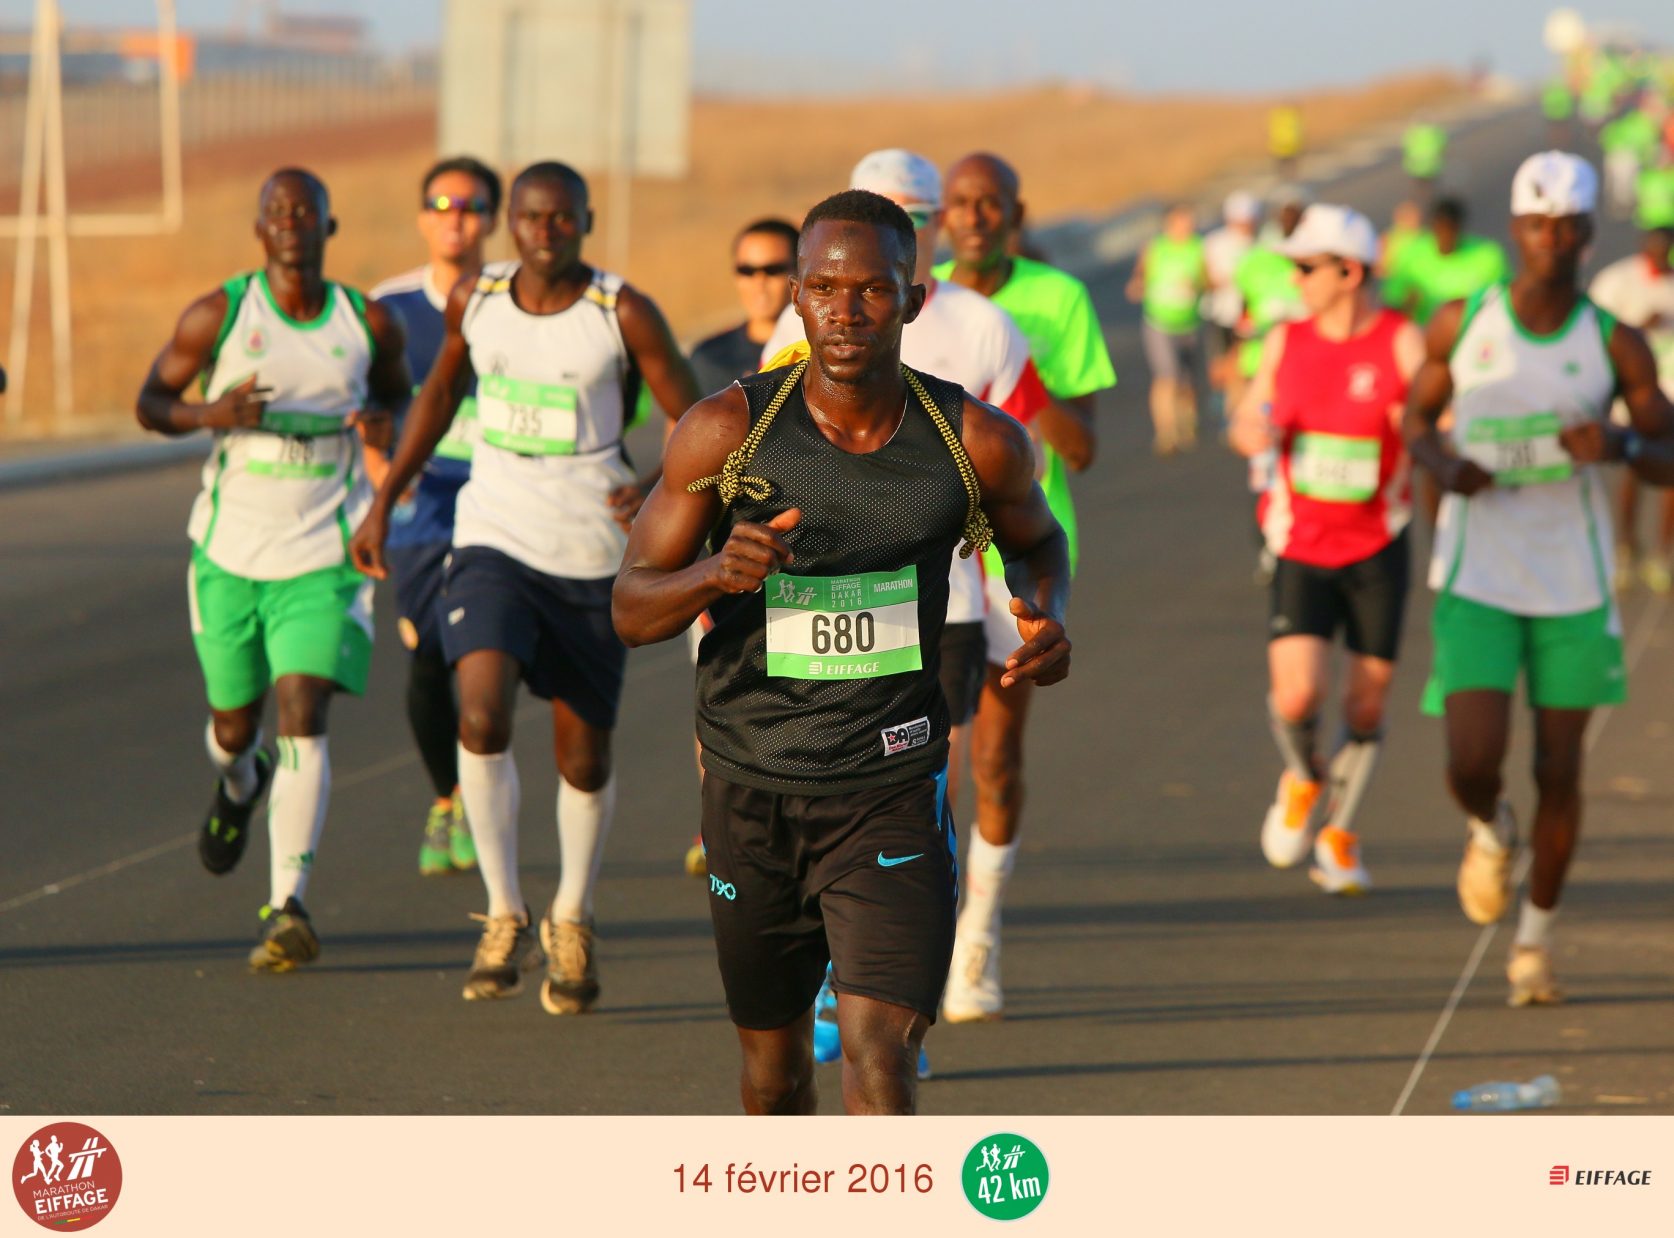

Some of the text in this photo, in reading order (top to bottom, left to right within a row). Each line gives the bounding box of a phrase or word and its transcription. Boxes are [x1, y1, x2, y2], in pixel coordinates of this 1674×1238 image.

[508, 404, 542, 436] 735
[830, 577, 861, 585] MARATHON
[831, 582, 862, 591] EIFFAGE
[873, 579, 913, 593] MARATHON
[811, 611, 875, 655] 680
[826, 661, 880, 676] EIFFAGE
[709, 873, 737, 900] T90
